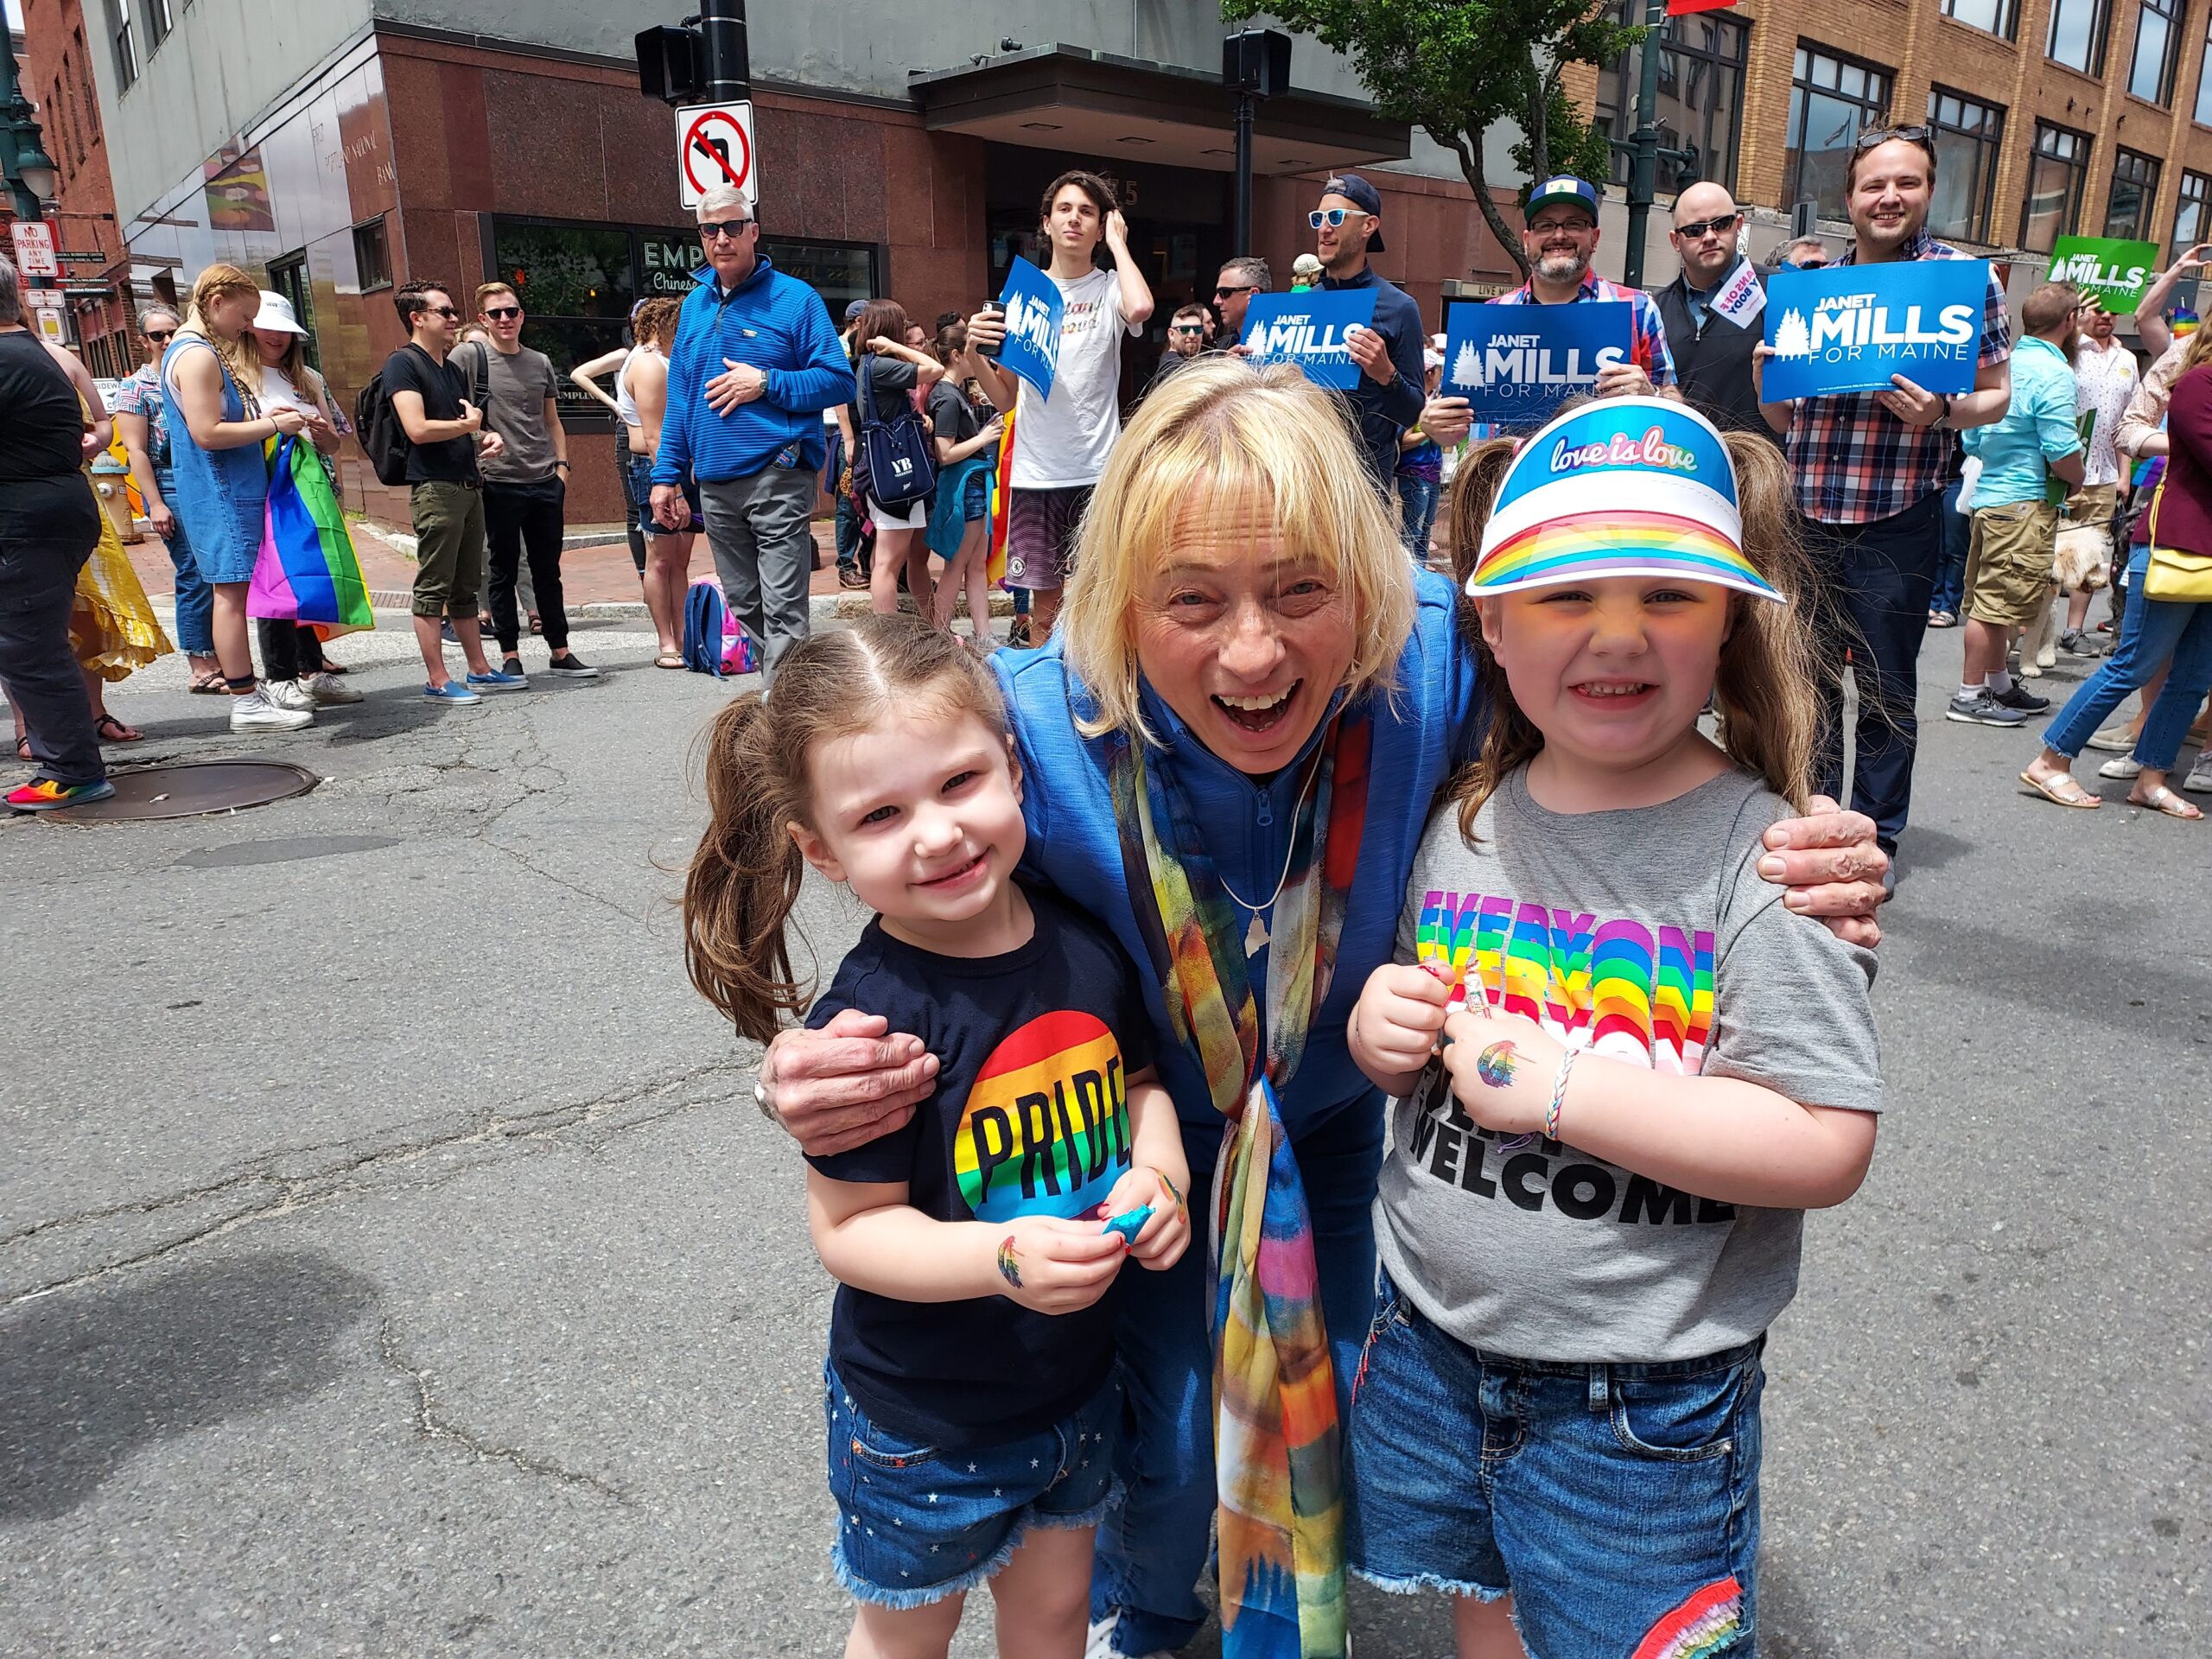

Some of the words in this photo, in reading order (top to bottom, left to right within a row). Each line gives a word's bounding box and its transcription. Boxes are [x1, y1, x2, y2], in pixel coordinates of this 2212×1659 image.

[23, 227, 38, 238] NO
[17, 239, 49, 250] PARKING
[2069, 253, 2099, 263] JANET
[653, 271, 698, 290] Chinese
[2066, 261, 2146, 289] MILLS
[1478, 285, 1497, 296] LIVE
[2090, 285, 2140, 298] MAINE
[1028, 295, 1051, 317] JANET
[1815, 293, 1877, 312] JANET
[1273, 315, 1312, 325] JANET
[1809, 304, 1975, 350] MILLS
[1014, 334, 1039, 359] FOR
[1486, 334, 1541, 348] JANET
[1262, 353, 1296, 365] FOR
[1808, 345, 1863, 365] FOR
[1878, 343, 1969, 361] MAINE
[1484, 384, 1530, 397] FOR
[1550, 438, 1608, 473] love
[1611, 435, 1641, 461] is
[1643, 429, 1699, 470] love
[891, 457, 913, 474] YB
